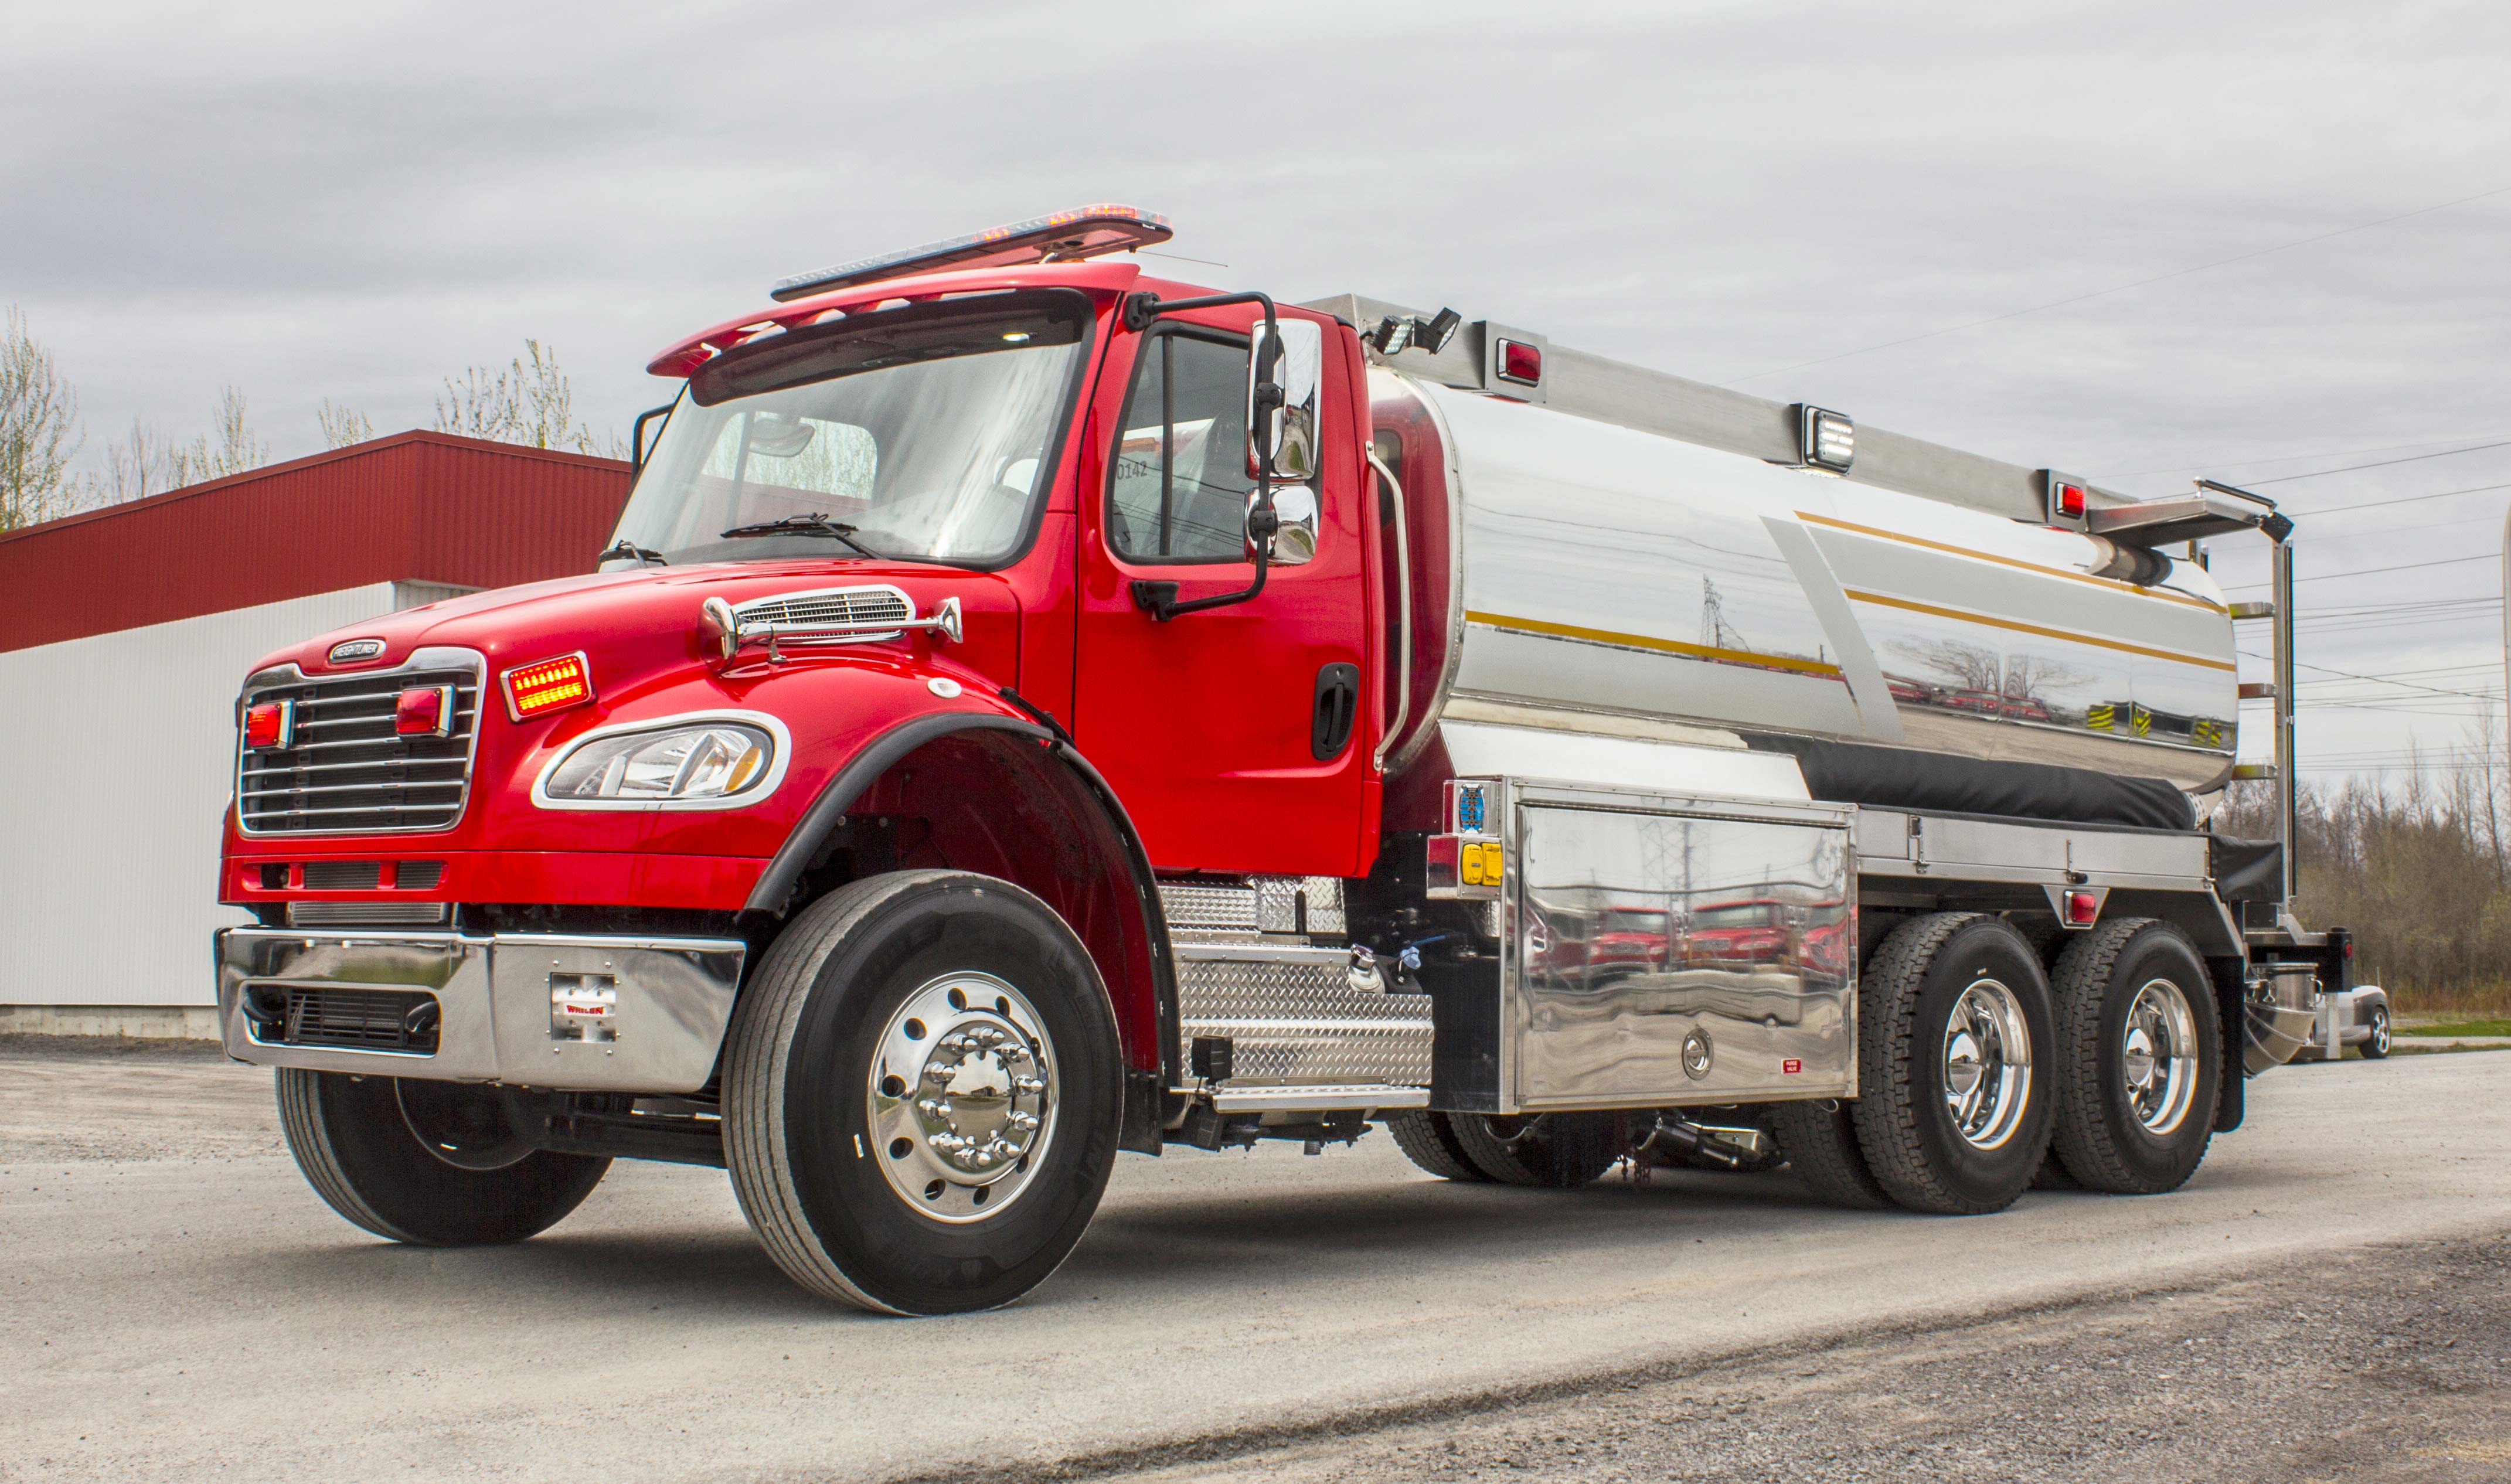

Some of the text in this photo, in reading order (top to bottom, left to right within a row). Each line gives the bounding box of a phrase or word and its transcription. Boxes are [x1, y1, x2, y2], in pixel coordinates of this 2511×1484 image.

[1117, 460, 1147, 480] 0142
[333, 644, 377, 656] FREIGHTLINER
[566, 1005, 604, 1015] WHELEN
